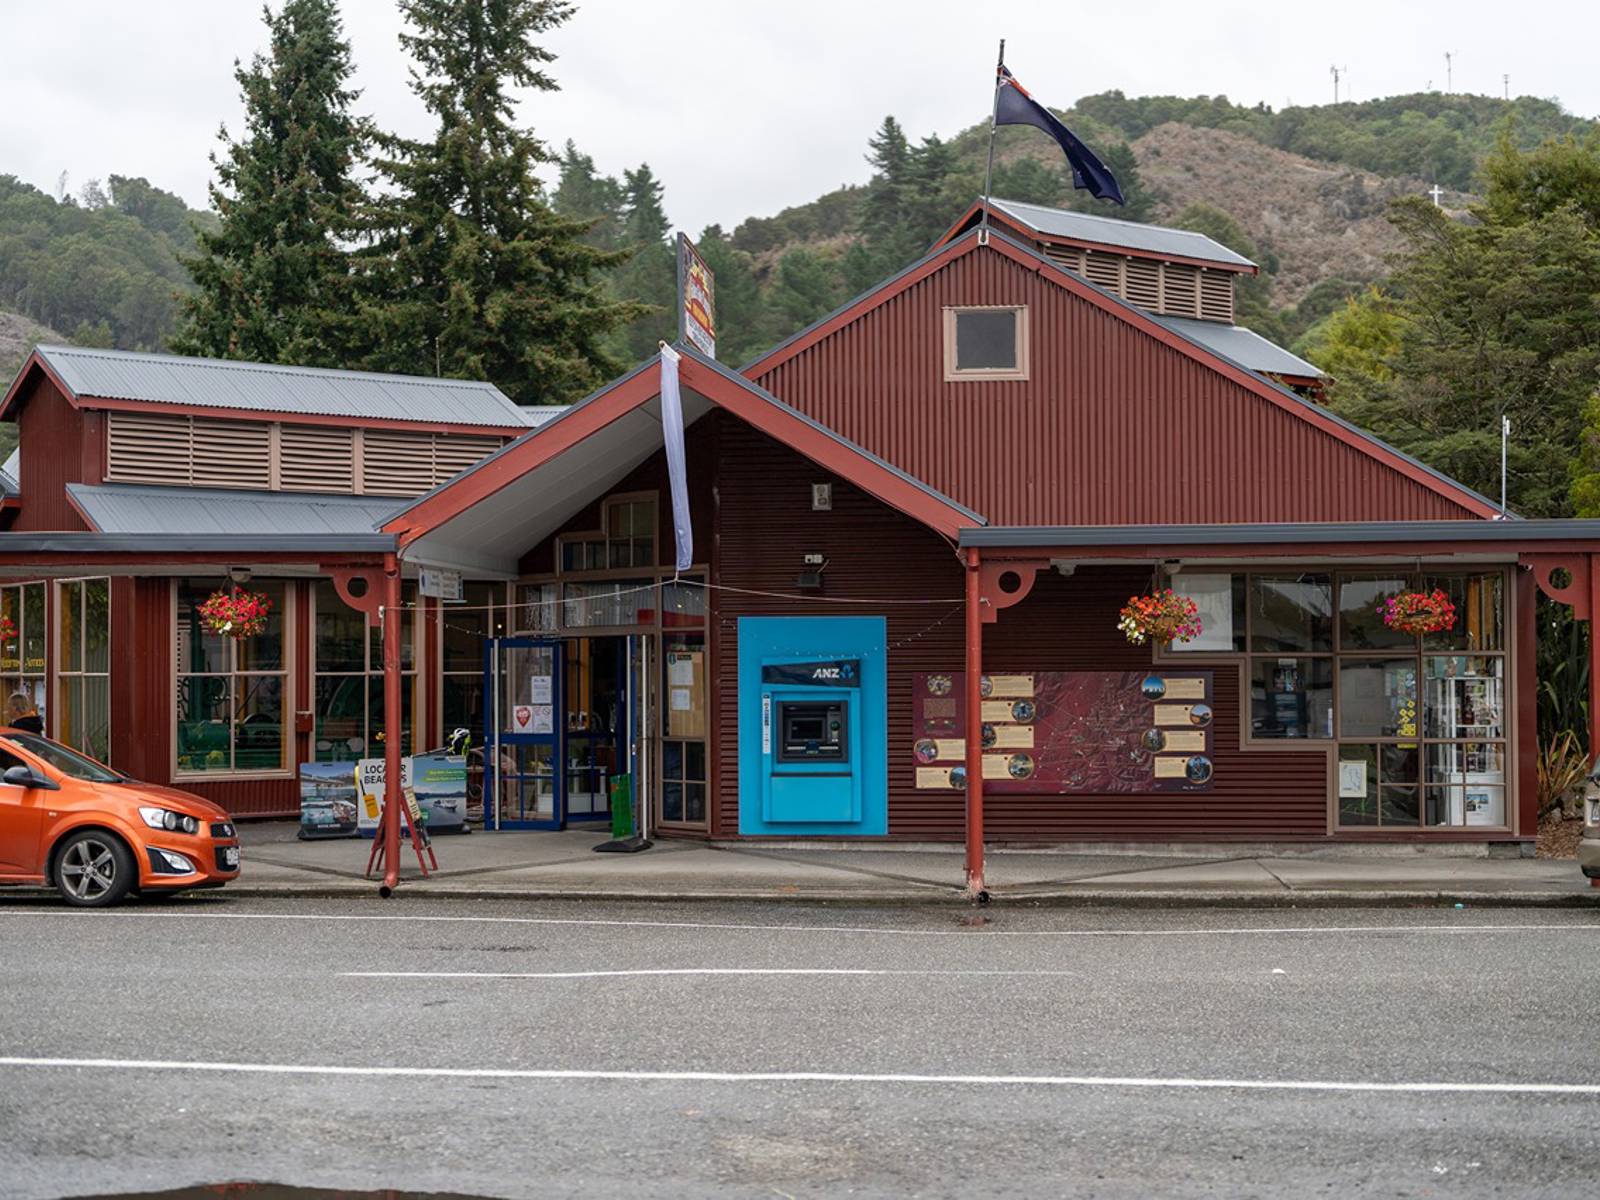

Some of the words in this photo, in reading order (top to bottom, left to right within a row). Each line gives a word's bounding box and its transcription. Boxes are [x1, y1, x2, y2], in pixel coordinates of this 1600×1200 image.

[812, 668, 840, 679] ANZ
[365, 764, 406, 774] LOCR
[364, 774, 407, 784] BEAS
